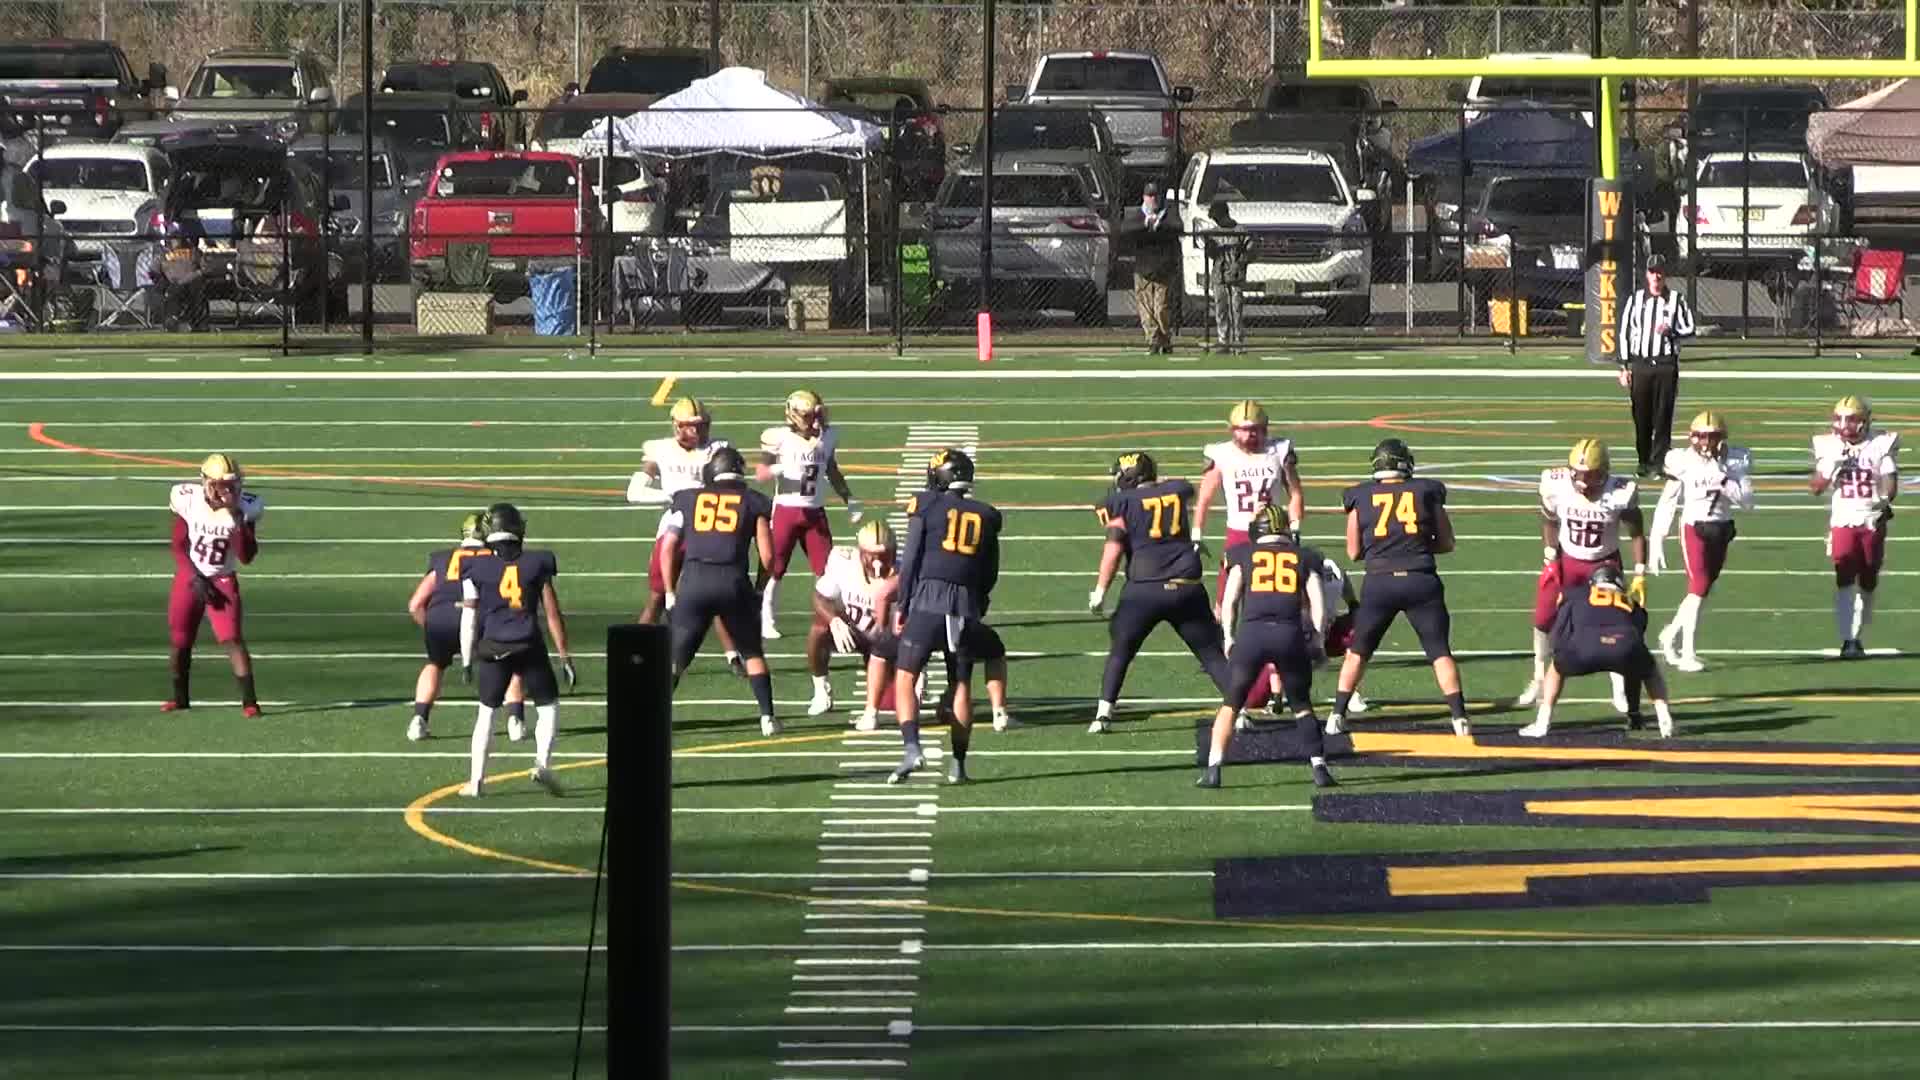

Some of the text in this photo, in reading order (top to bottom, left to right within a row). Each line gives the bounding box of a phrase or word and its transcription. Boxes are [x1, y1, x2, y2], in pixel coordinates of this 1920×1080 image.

[693, 492, 741, 533] 65
[1141, 493, 1181, 539] 77
[1371, 490, 1418, 537] 74
[1705, 489, 1722, 517] 7
[941, 508, 982, 555] 10
[499, 565, 522, 609] 4
[1250, 551, 1299, 593] 26
